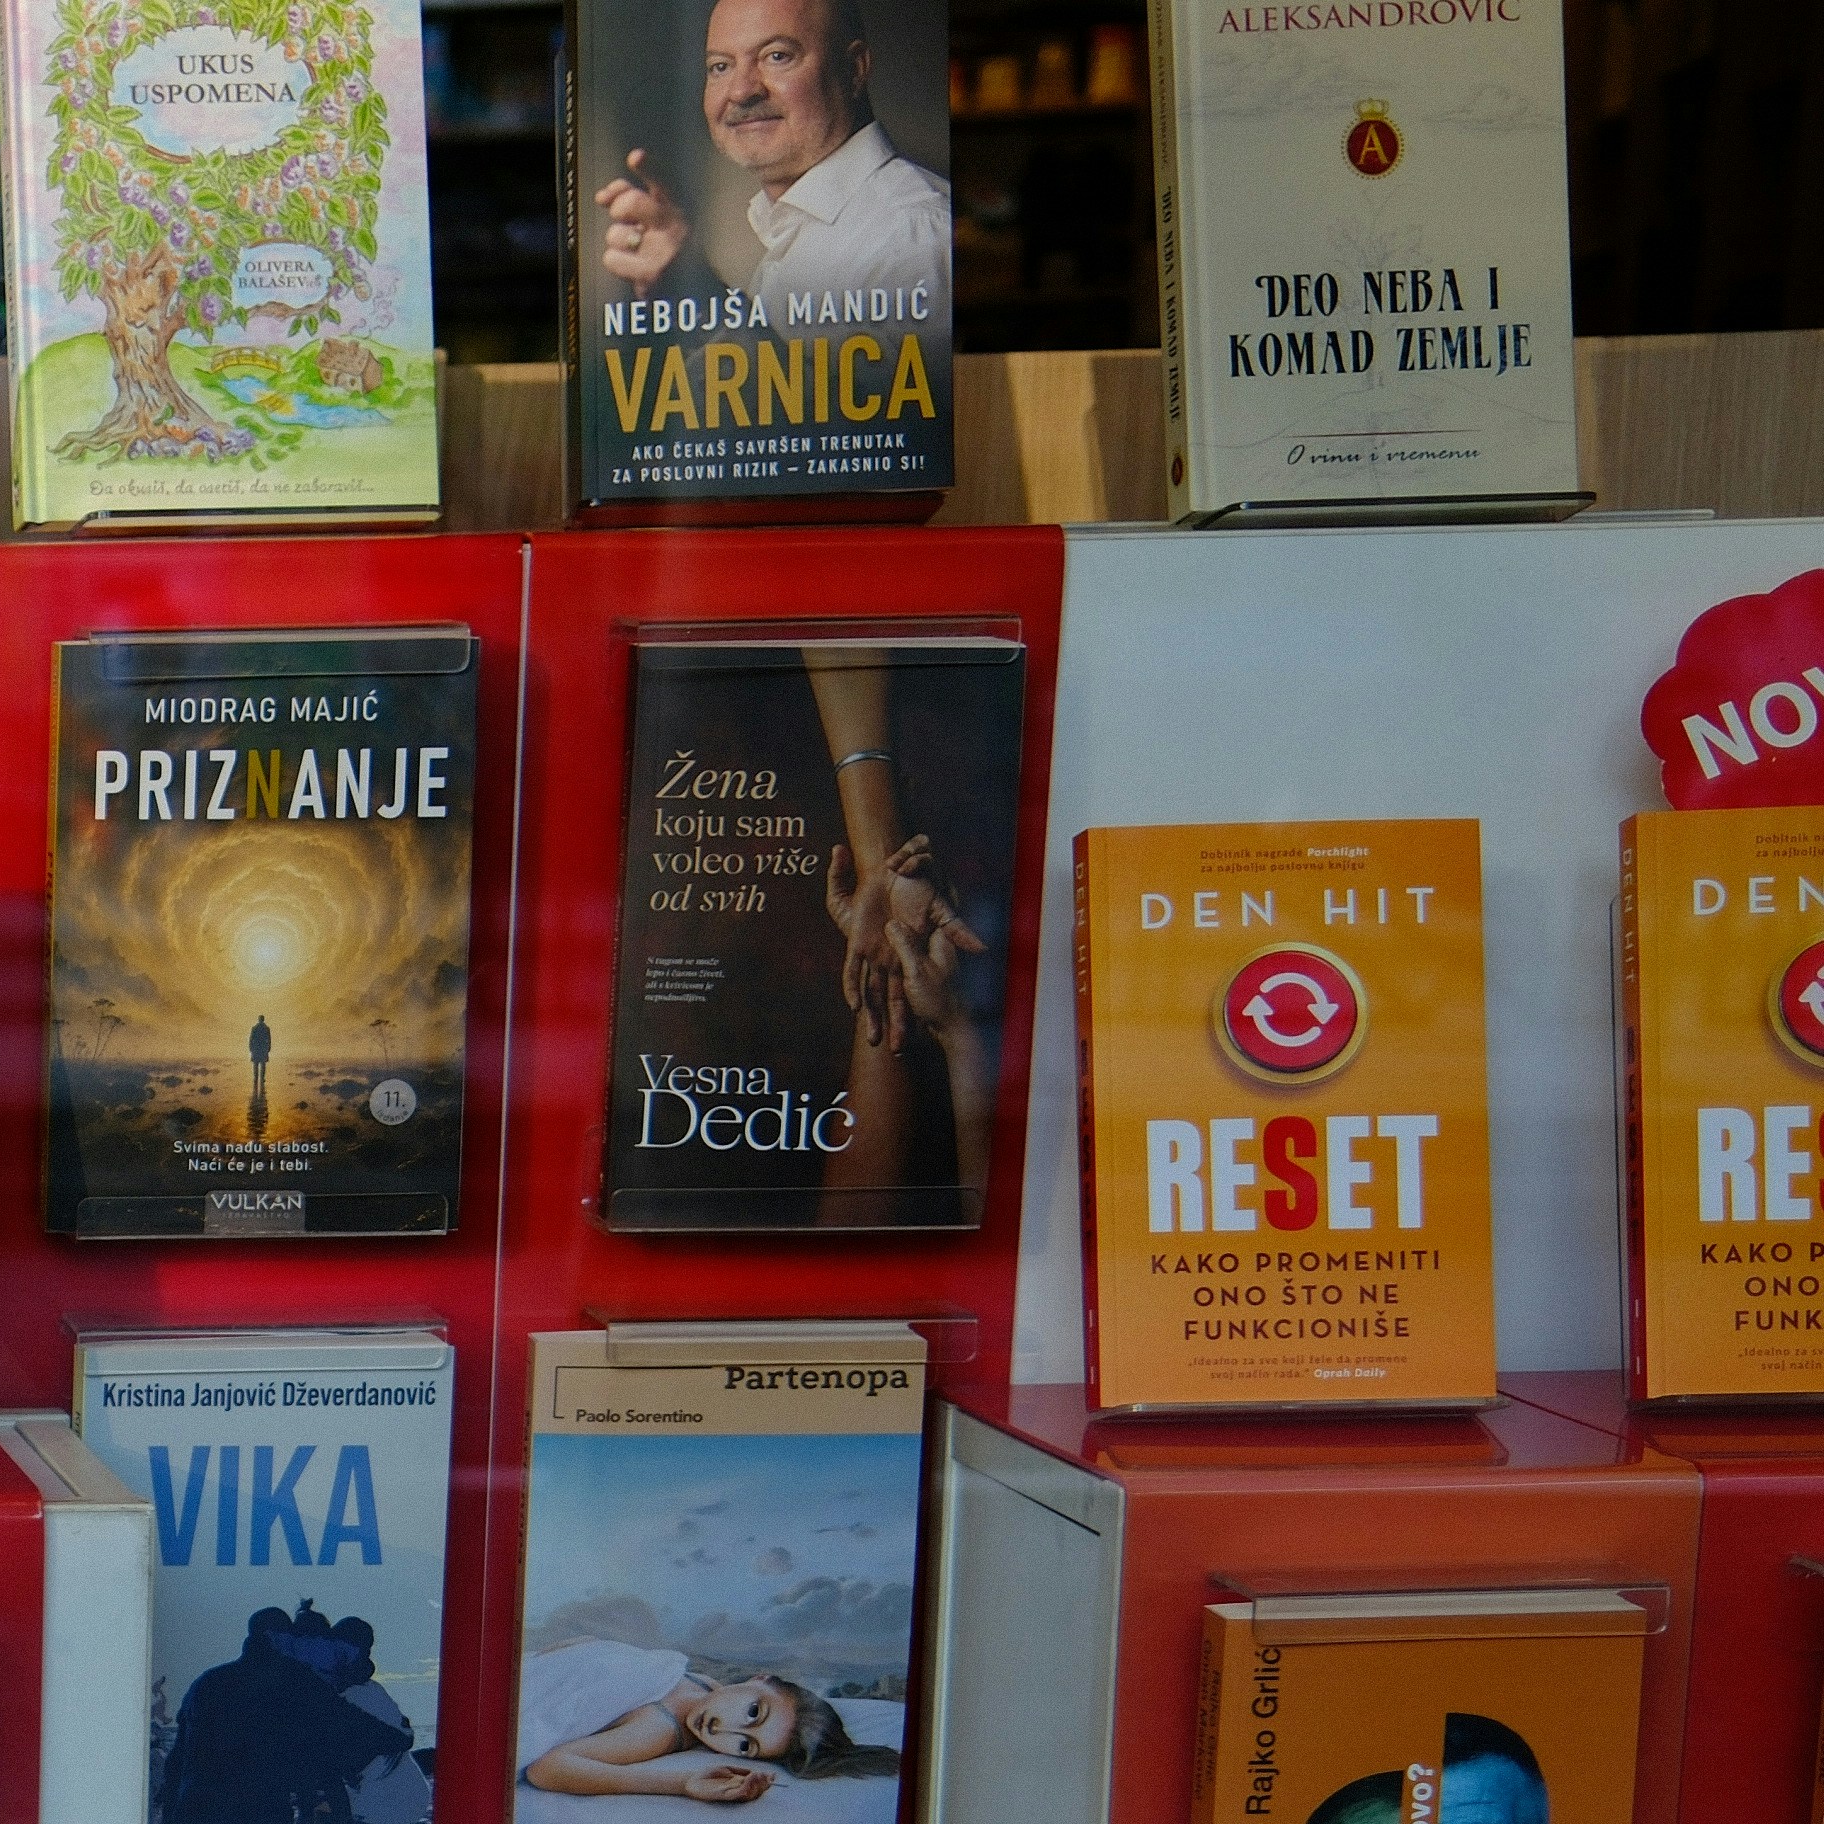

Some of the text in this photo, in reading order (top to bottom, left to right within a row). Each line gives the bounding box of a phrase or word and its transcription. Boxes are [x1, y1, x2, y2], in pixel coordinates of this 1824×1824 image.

[178, 54, 254, 74] UKUS
[130, 82, 296, 105] USPOMENA
[244, 260, 315, 274] OLIVERA
[604, 280, 930, 335] NEBOJŠA MANDIĆ
[1256, 268, 1499, 317] DEO NEBA I
[1230, 324, 1532, 378] KOMAD ZEMLJE
[604, 334, 937, 434] VARNICA
[632, 433, 904, 460] AKO ČEKAŠ SAVRŠEN TRENUTAK
[612, 454, 925, 484] ZA POSLOVNI RIZIK ZAKASNIO SI!
[146, 690, 378, 723] MIODRAG MAJIĆ
[95, 747, 449, 820] PRIZNANJE
[656, 750, 776, 800] Žena
[655, 808, 804, 842] koju sam
[652, 846, 818, 875] voleo više
[650, 884, 766, 912] od svih
[1142, 886, 1436, 930] DEN HIT
[639, 1054, 771, 1095] Vesna
[384, 1091, 406, 1108] 11.
[635, 1088, 854, 1152] Dedić
[174, 1140, 328, 1154] Svima nađu slabost.
[188, 1158, 222, 1171] Naći
[227, 1158, 245, 1172] će
[249, 1160, 264, 1175] je
[280, 1158, 312, 1171] tebi.
[1148, 1114, 1438, 1232] RESET
[211, 1194, 302, 1210] VULKAN
[1152, 1250, 1440, 1274] KAKO PROMENITI
[1194, 1278, 1398, 1306] ONO ŠTO NE
[1185, 1312, 1409, 1340] FUNKCIONIŠE
[721, 1365, 908, 1396] Partenopa
[103, 1382, 436, 1412] Kristina Janjović Dževerdanović
[575, 1408, 702, 1424] Paolo Sorentino
[150, 1446, 382, 1566] VIKA
[1245, 1647, 1281, 1814] Rajko Grlić
